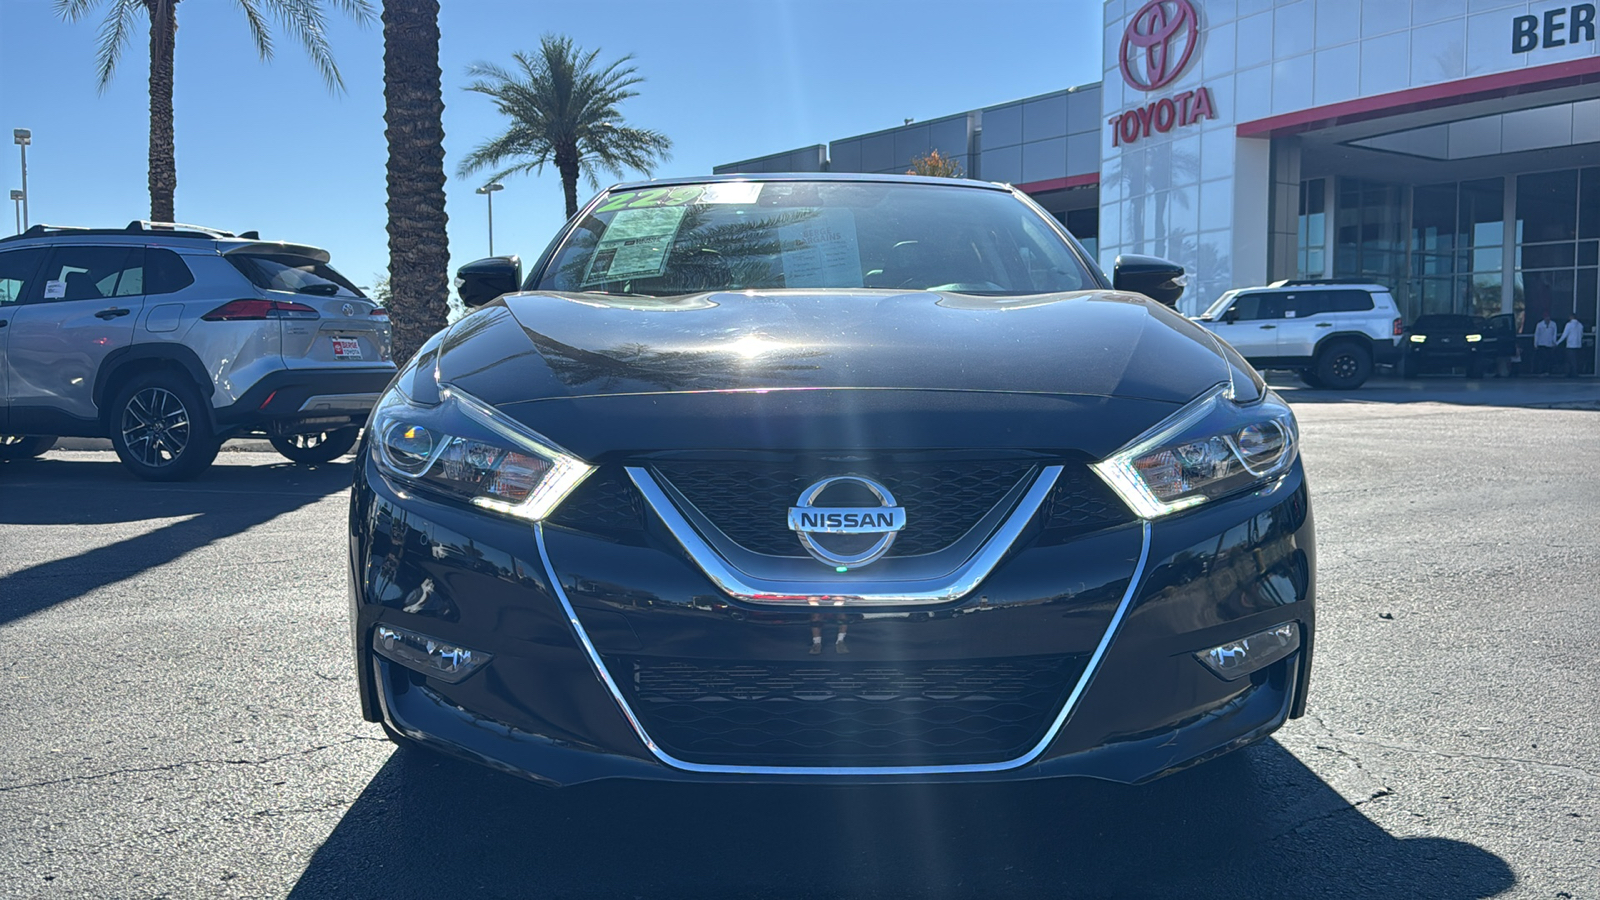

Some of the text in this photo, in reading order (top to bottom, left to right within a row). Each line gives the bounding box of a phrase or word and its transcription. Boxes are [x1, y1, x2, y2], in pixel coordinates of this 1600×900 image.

[1511, 3, 1596, 54] BER
[1108, 87, 1214, 148] TOYOTA
[803, 227, 832, 238] BERGE
[801, 512, 894, 528] NISSAN
